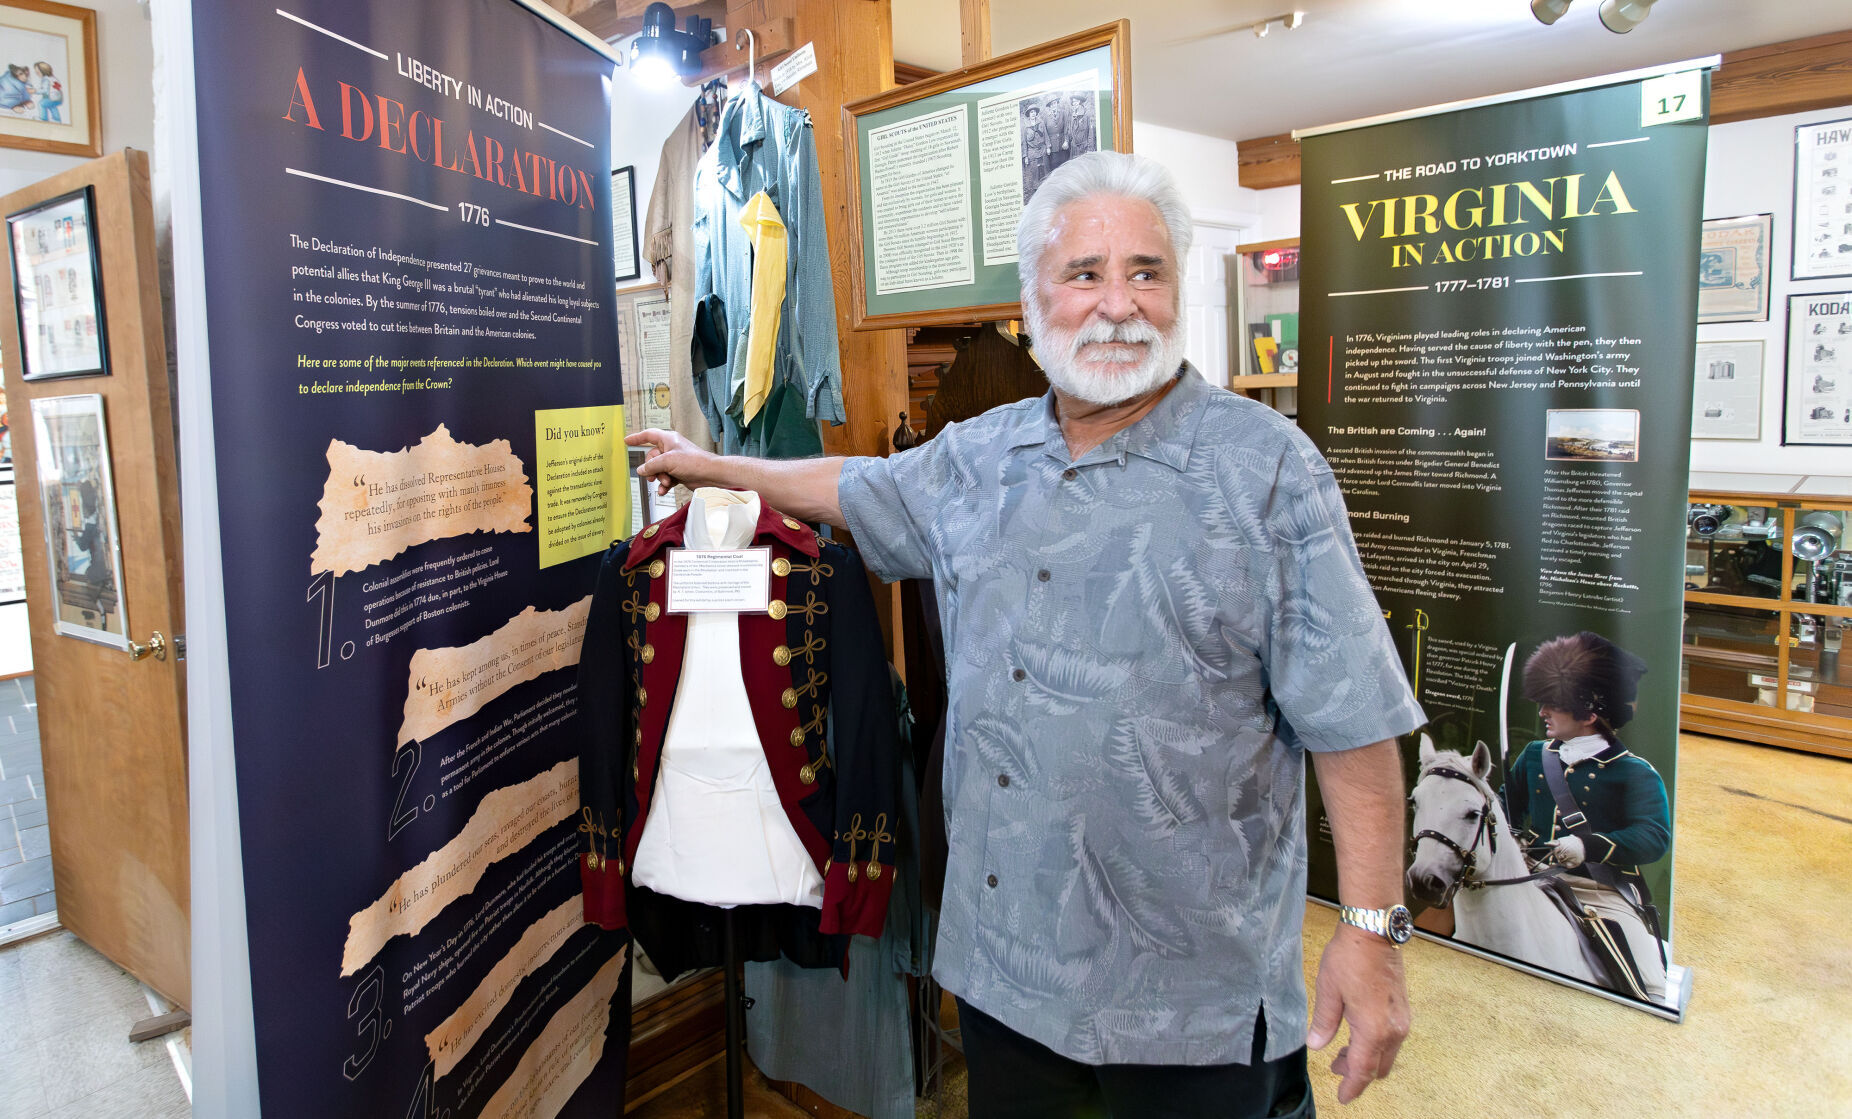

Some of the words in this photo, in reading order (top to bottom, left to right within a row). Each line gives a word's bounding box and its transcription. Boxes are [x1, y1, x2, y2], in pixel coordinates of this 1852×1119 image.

[397, 52, 463, 100] LIBERTY
[468, 84, 482, 108] IN
[485, 94, 533, 130] ACTION
[1658, 94, 1686, 115] 17
[282, 66, 326, 131] A
[337, 80, 595, 211] DECLARATION
[1384, 167, 1411, 182] THE
[1416, 161, 1457, 178] ROAD
[1461, 158, 1480, 171] TO
[1485, 142, 1577, 168] YORKTOWN
[458, 202, 490, 227] 1776
[1339, 169, 1638, 242] VIRGINIA
[1391, 243, 1425, 268] IN
[1432, 228, 1568, 265] ACTION
[290, 234, 309, 249] The
[312, 237, 364, 257] Declaration
[367, 247, 376, 259] of
[378, 248, 426, 267] Independence
[427, 260, 462, 272] presented
[464, 263, 472, 273] 27
[474, 265, 501, 278] grievances
[503, 272, 520, 281] meant
[521, 274, 527, 282] to
[529, 276, 544, 286] prove
[546, 277, 551, 285] to
[553, 277, 561, 286] the
[563, 279, 575, 288] world
[292, 265, 335, 279] potential
[337, 268, 359, 281] allies
[361, 270, 380, 283] that
[382, 272, 401, 290] King
[402, 275, 423, 292] George
[433, 283, 445, 291] was
[454, 283, 474, 294] brutal
[498, 289, 510, 299] who
[511, 290, 521, 300] had
[522, 292, 547, 303] alienated
[558, 297, 568, 308] long
[569, 298, 580, 309] loyal
[581, 300, 599, 312] subjects
[1434, 276, 1510, 293] 1777–1781
[293, 289, 302, 301] in
[306, 290, 321, 303] the
[324, 292, 363, 306] colonies.
[366, 295, 377, 311] By
[380, 296, 394, 308] the
[396, 301, 420, 311] summer
[421, 301, 427, 311] of
[429, 302, 447, 315] 1776,
[450, 305, 477, 315] tensions
[478, 306, 494, 317] boiled
[509, 310, 518, 319] and
[520, 310, 529, 320] the
[531, 311, 551, 322] Second
[552, 313, 582, 324] Continental
[295, 314, 339, 334] Congress
[342, 319, 366, 330] voted
[369, 322, 378, 331] to
[381, 323, 394, 332] cut
[396, 323, 408, 332] ties
[409, 322, 432, 334] between
[434, 324, 459, 335] Britain
[462, 327, 474, 336] and
[475, 327, 484, 336] the
[486, 328, 511, 338] American
[512, 329, 536, 340] colonies.
[1356, 334, 1374, 342] 1776,
[1376, 333, 1412, 343] Virginians
[1414, 331, 1439, 342] played
[1441, 330, 1469, 339] leading
[1502, 326, 1542, 336] declaring
[1544, 325, 1586, 334] American
[1346, 346, 1397, 356] independence.
[1399, 344, 1426, 354] Having
[1428, 343, 1452, 351] served
[1495, 340, 1504, 349] of
[1505, 340, 1532, 350] liberty
[1536, 339, 1554, 347] with
[1573, 340, 1592, 348] pen,
[1595, 338, 1616, 347] they
[299, 383, 308, 394] to
[311, 380, 343, 393] declare
[346, 380, 401, 396] independence
[402, 379, 414, 394] from
[415, 379, 424, 390] the
[426, 378, 452, 390] Crown?
[1391, 382, 1408, 392] fight
[1420, 382, 1460, 392] campaigns
[1509, 380, 1537, 390] Jersey
[1558, 379, 1616, 390] Pennsylvania
[1619, 379, 1640, 388] until
[546, 427, 561, 440] Did
[564, 429, 579, 442] you
[581, 422, 605, 437] know?
[1328, 426, 1345, 435] The
[1347, 426, 1378, 435] British
[1397, 427, 1435, 437] Coming
[1454, 428, 1486, 438] Again!
[386, 482, 398, 493] has
[400, 474, 426, 490] dissolved
[428, 468, 483, 485] Representative
[484, 464, 505, 475] Houses
[1373, 511, 1410, 524] Burning
